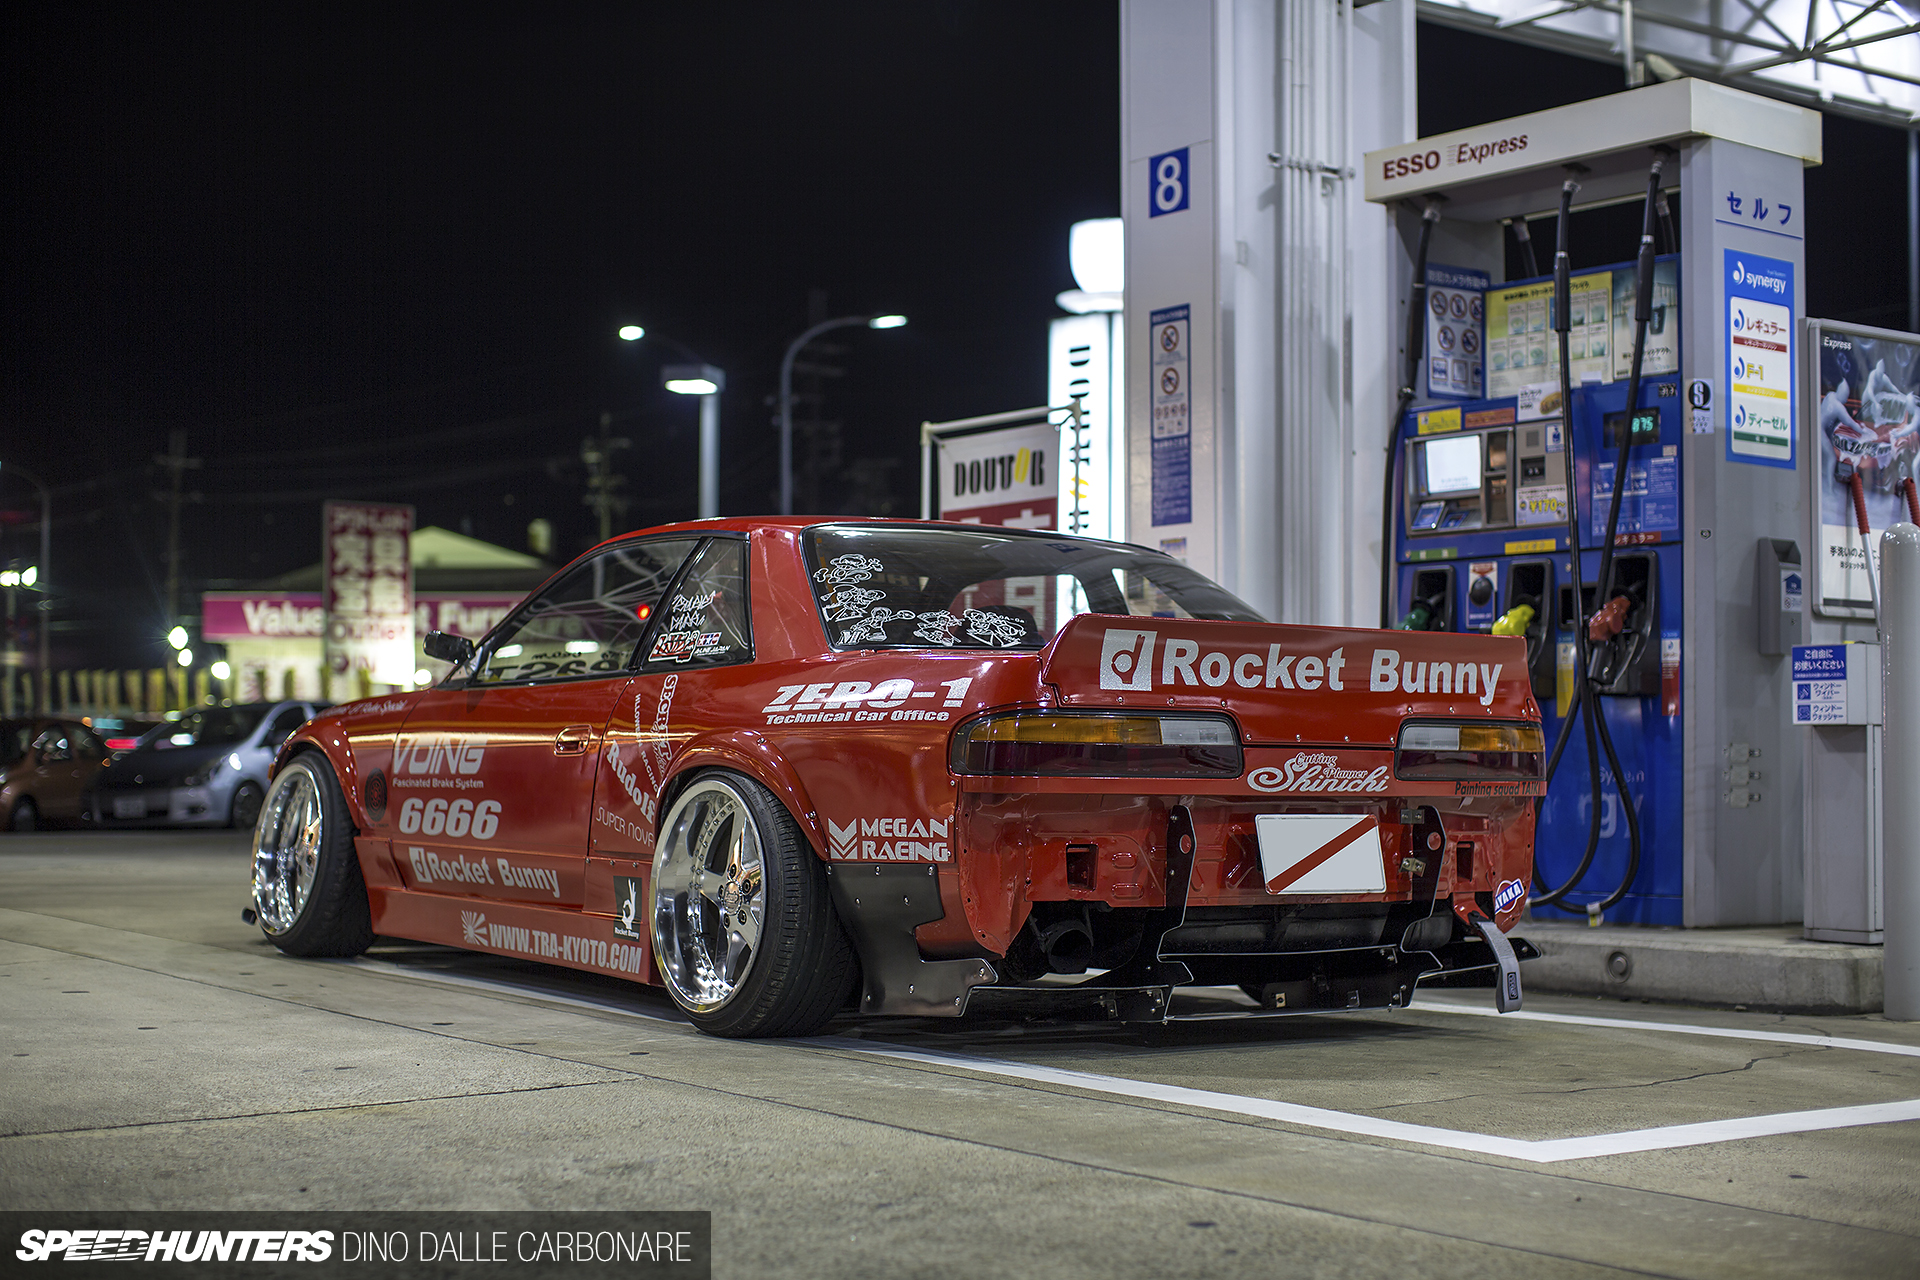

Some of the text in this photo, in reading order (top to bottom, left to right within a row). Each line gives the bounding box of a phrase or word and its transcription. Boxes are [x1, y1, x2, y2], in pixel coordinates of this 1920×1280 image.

[1383, 134, 1529, 180] ESSO Express
[1155, 156, 1183, 211] 8
[1727, 191, 1792, 225] セルフ
[1746, 272, 1786, 294] synergy
[1747, 317, 1787, 335] レギュラー
[1824, 337, 1852, 350] Express
[1747, 363, 1764, 380] F-1
[1748, 412, 1788, 431] ディーゼル
[954, 446, 1045, 497] DOUTOR
[1794, 660, 1845, 671] お使いください
[1804, 649, 1834, 659] ご自由に
[1162, 643, 1502, 706] Rocket Bunny
[762, 678, 974, 713] ZERO-1
[766, 709, 949, 725] Technical Car Office
[392, 778, 484, 790] Fascinated Brake System
[606, 739, 656, 824] Rudolf
[641, 750, 659, 793] RACING
[1455, 781, 1492, 796] Painting
[1493, 781, 1520, 796] squad
[399, 797, 502, 840] 6666
[595, 806, 626, 835] SUPER
[861, 818, 948, 838] MEGAN
[427, 852, 561, 898] Rocket Bunny
[488, 923, 642, 974] WWW.TRA-KYOTO.COM
